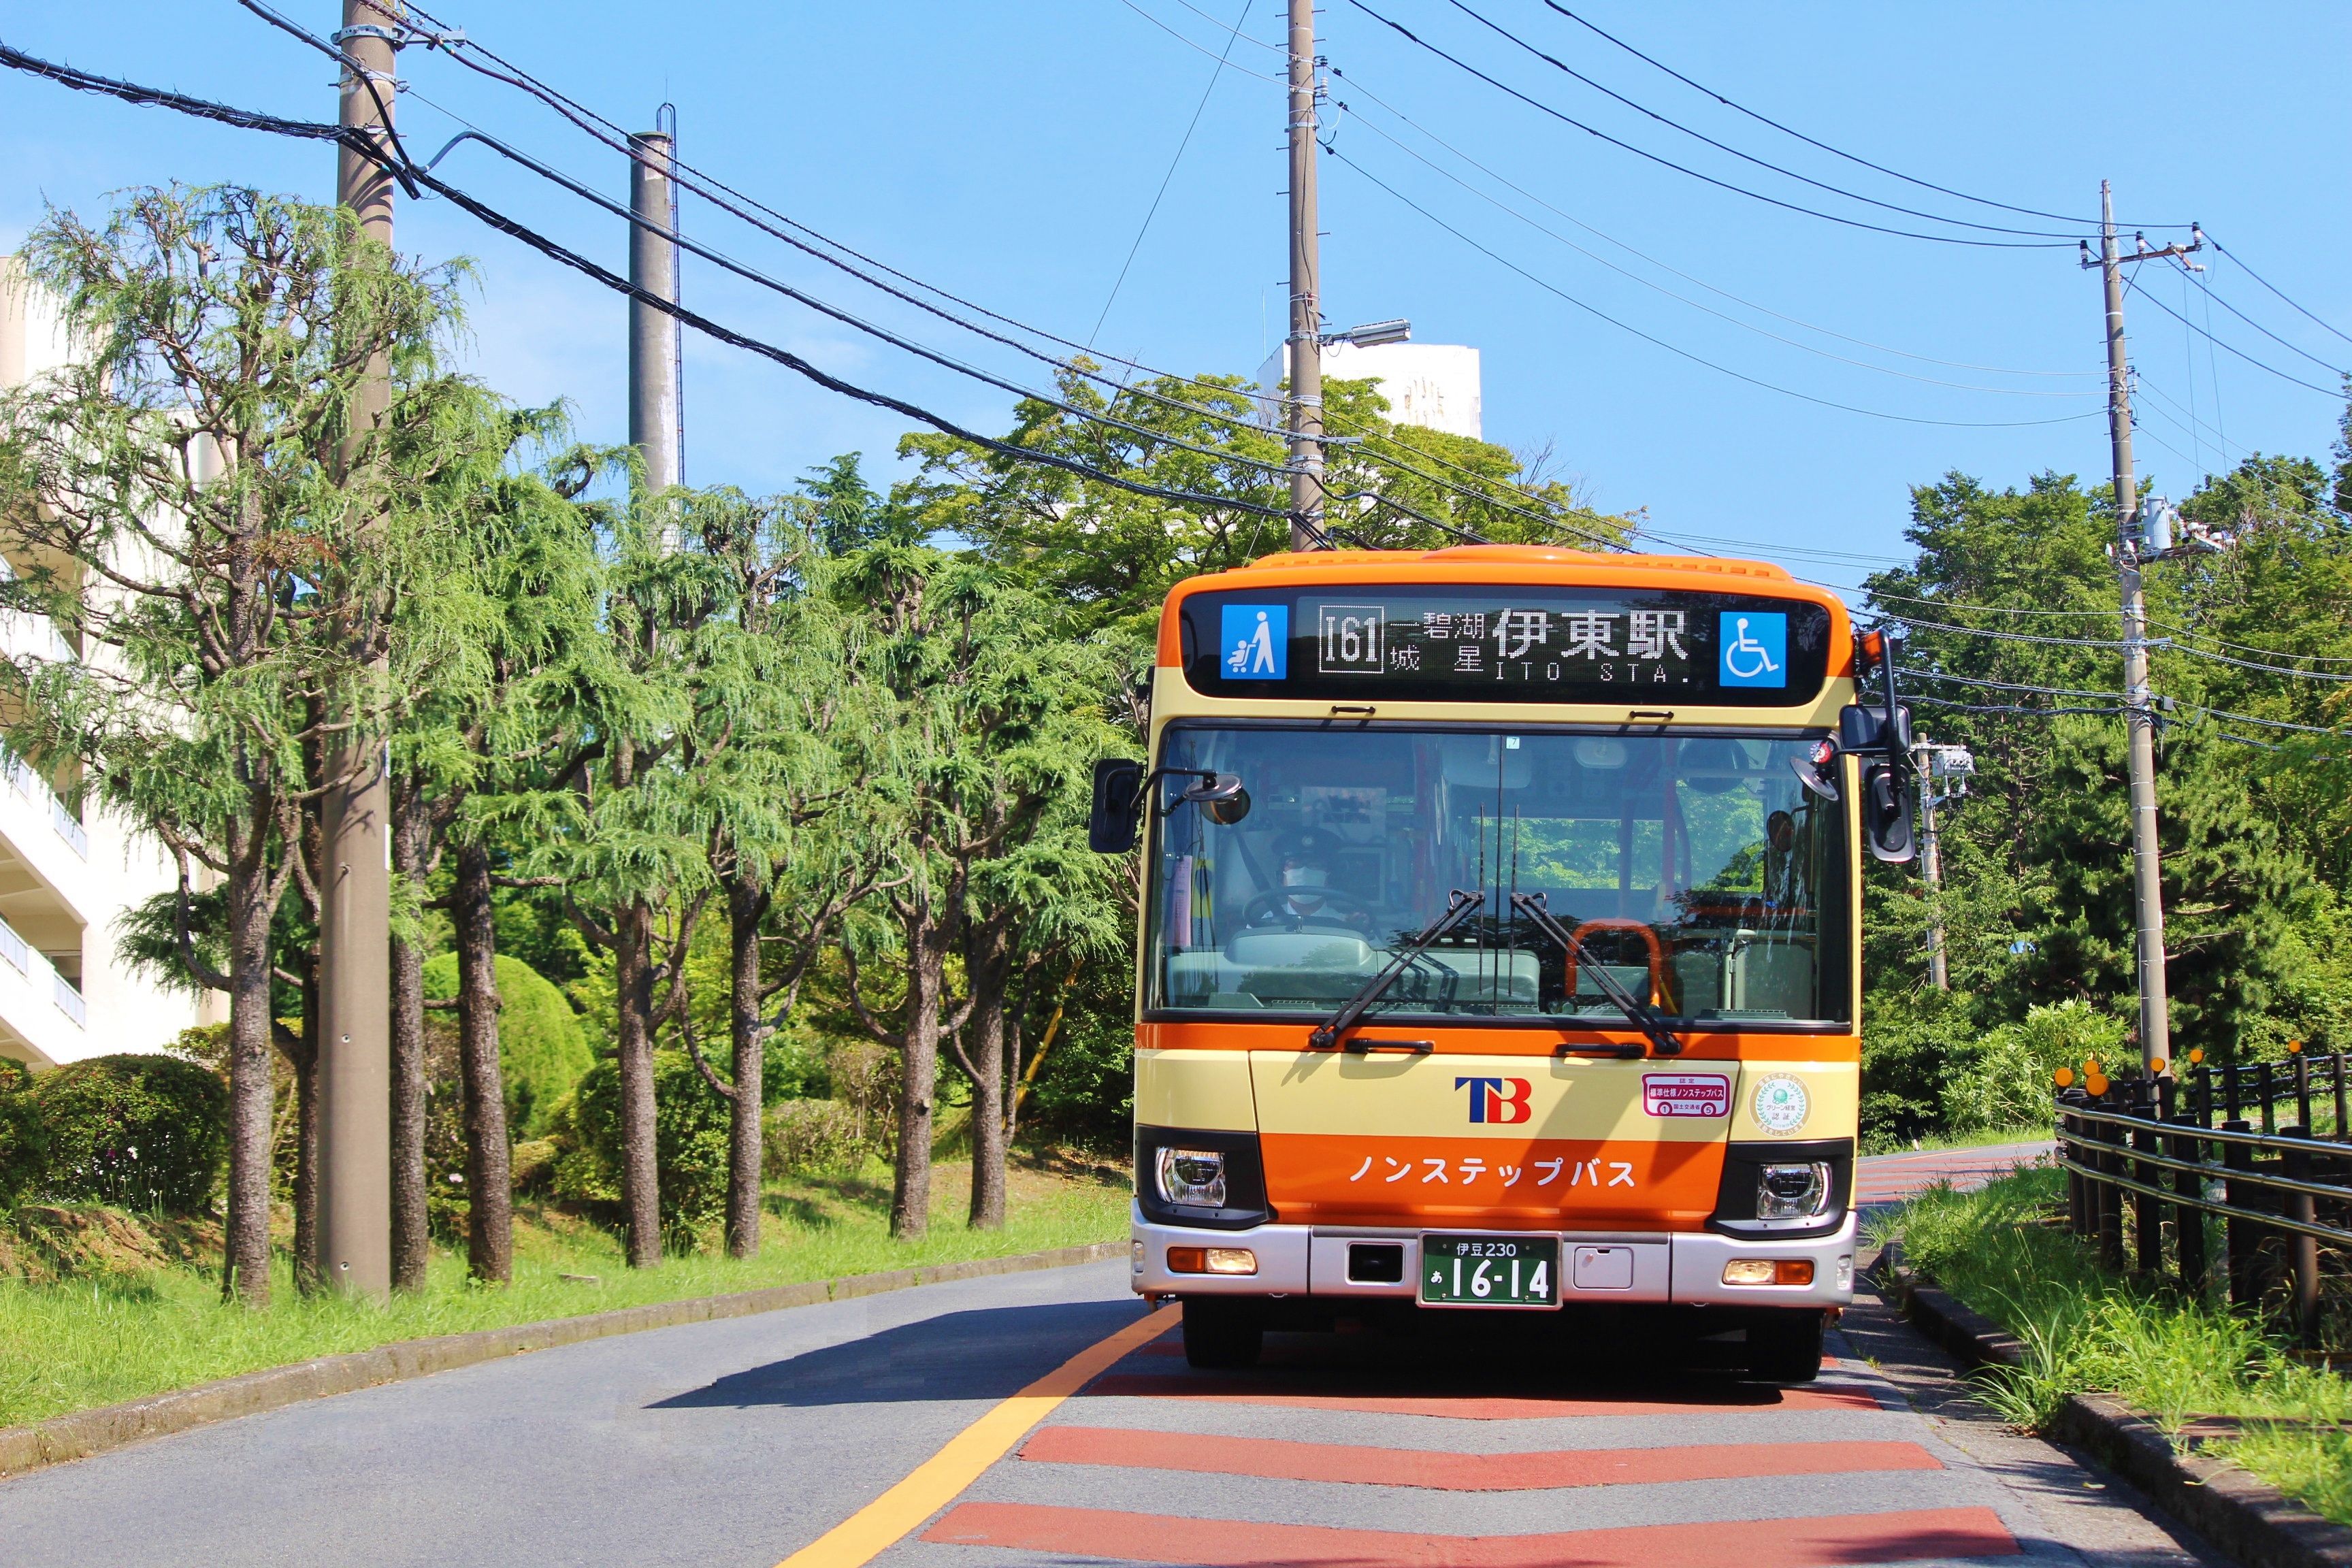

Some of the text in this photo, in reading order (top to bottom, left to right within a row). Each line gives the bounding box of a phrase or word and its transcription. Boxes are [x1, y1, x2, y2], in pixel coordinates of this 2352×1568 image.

[1326, 616, 1377, 662] I61
[1390, 612, 1485, 639] 一碧湖
[1492, 608, 1688, 660] 伊東駅
[1496, 662, 1688, 683] ITO STA.
[1455, 1077, 1532, 1124] TB
[1650, 1088, 1724, 1098] 標準仕様ノンステップバス
[1350, 1156, 1635, 1188] ノンステップバス
[1431, 1258, 1549, 1298] あ 16-14
